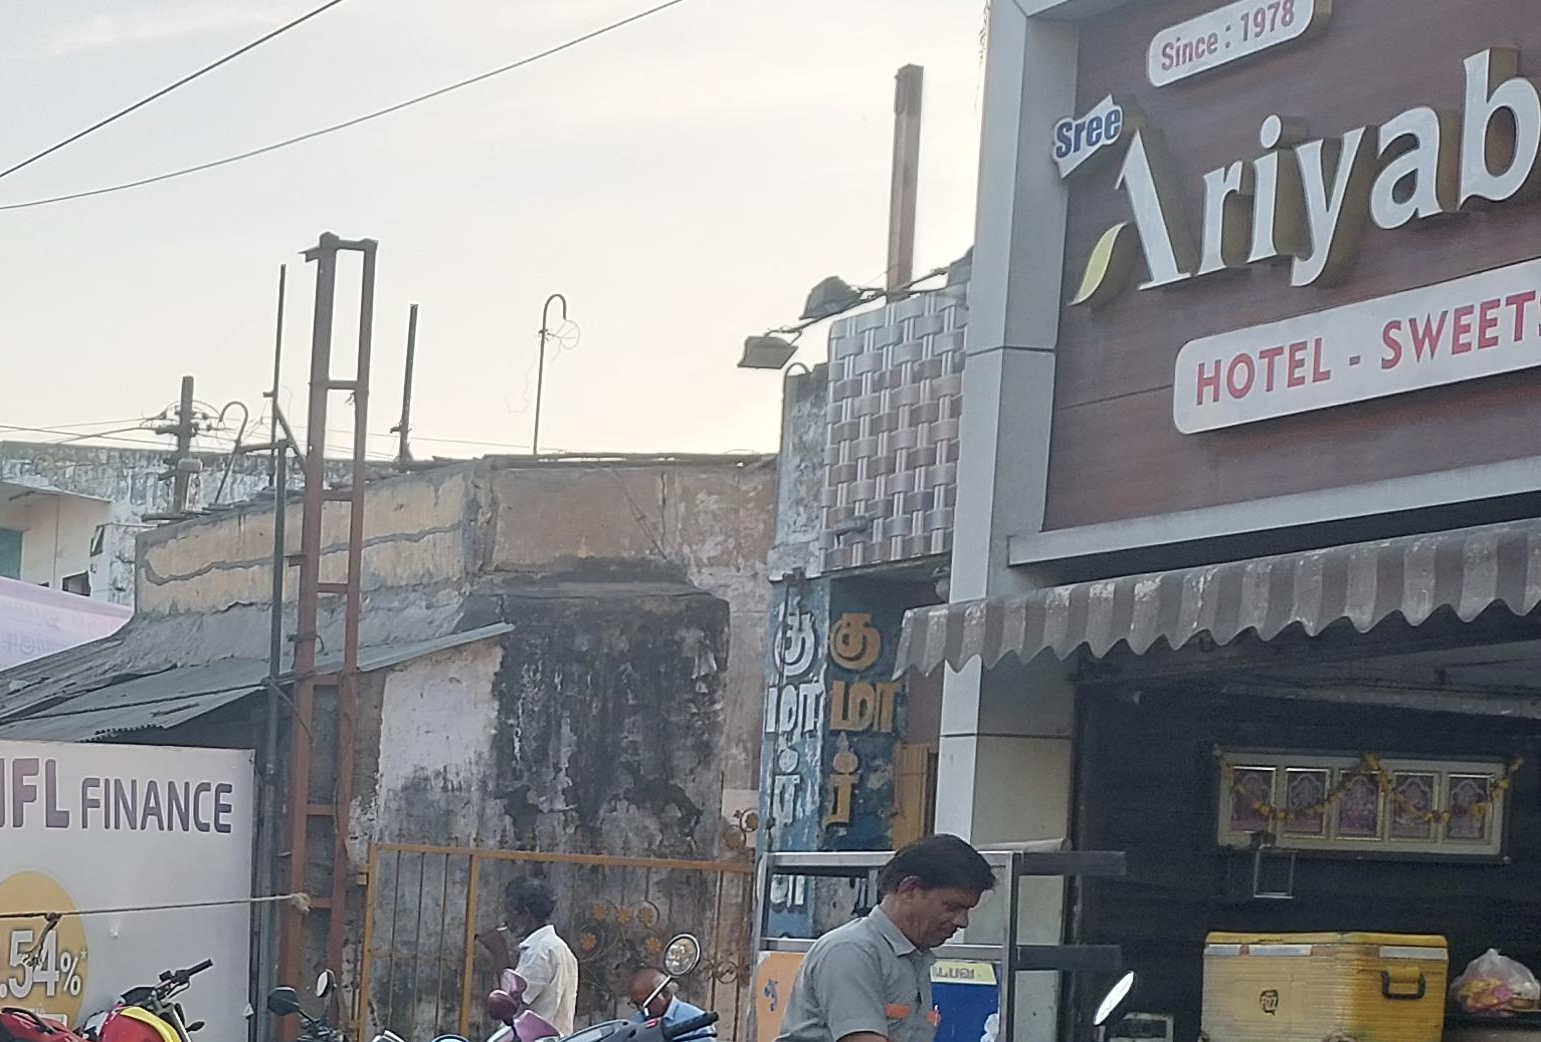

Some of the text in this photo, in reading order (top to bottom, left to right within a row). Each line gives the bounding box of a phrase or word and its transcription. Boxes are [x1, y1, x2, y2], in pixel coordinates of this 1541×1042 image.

[1161, 31, 1218, 72] Since
[1239, 0, 1295, 43] 1978
[1055, 106, 1121, 159] Sree
[1195, 338, 1331, 406] HOTEL
[1381, 290, 1541, 370] SWEET
[826, 612, 901, 830] குமார்
[81, 777, 234, 834] FINANCE
